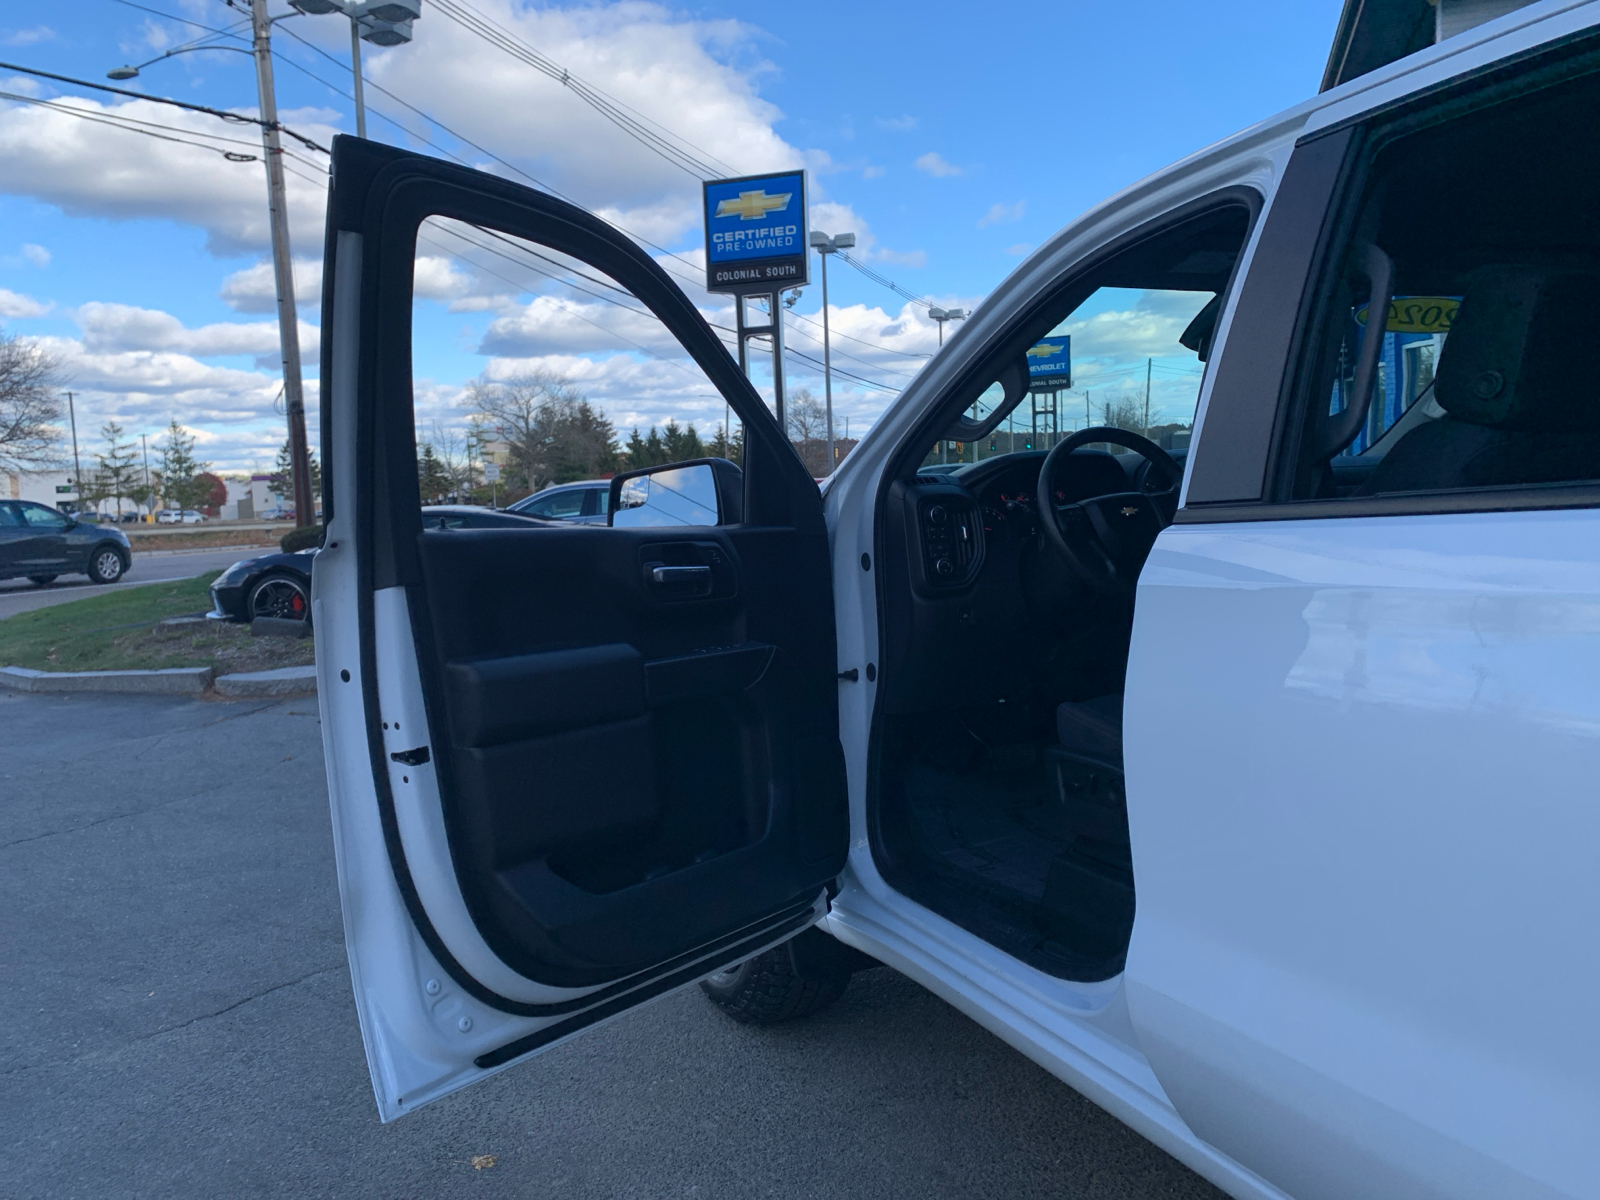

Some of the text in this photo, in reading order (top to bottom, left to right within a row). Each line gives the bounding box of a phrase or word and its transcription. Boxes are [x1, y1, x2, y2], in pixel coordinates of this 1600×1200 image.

[713, 225, 797, 242] CERTIFIED
[717, 236, 793, 252] PRE-OWNED
[716, 265, 796, 281] COLONIAL SOUTH
[1029, 362, 1066, 372] HEVROLET
